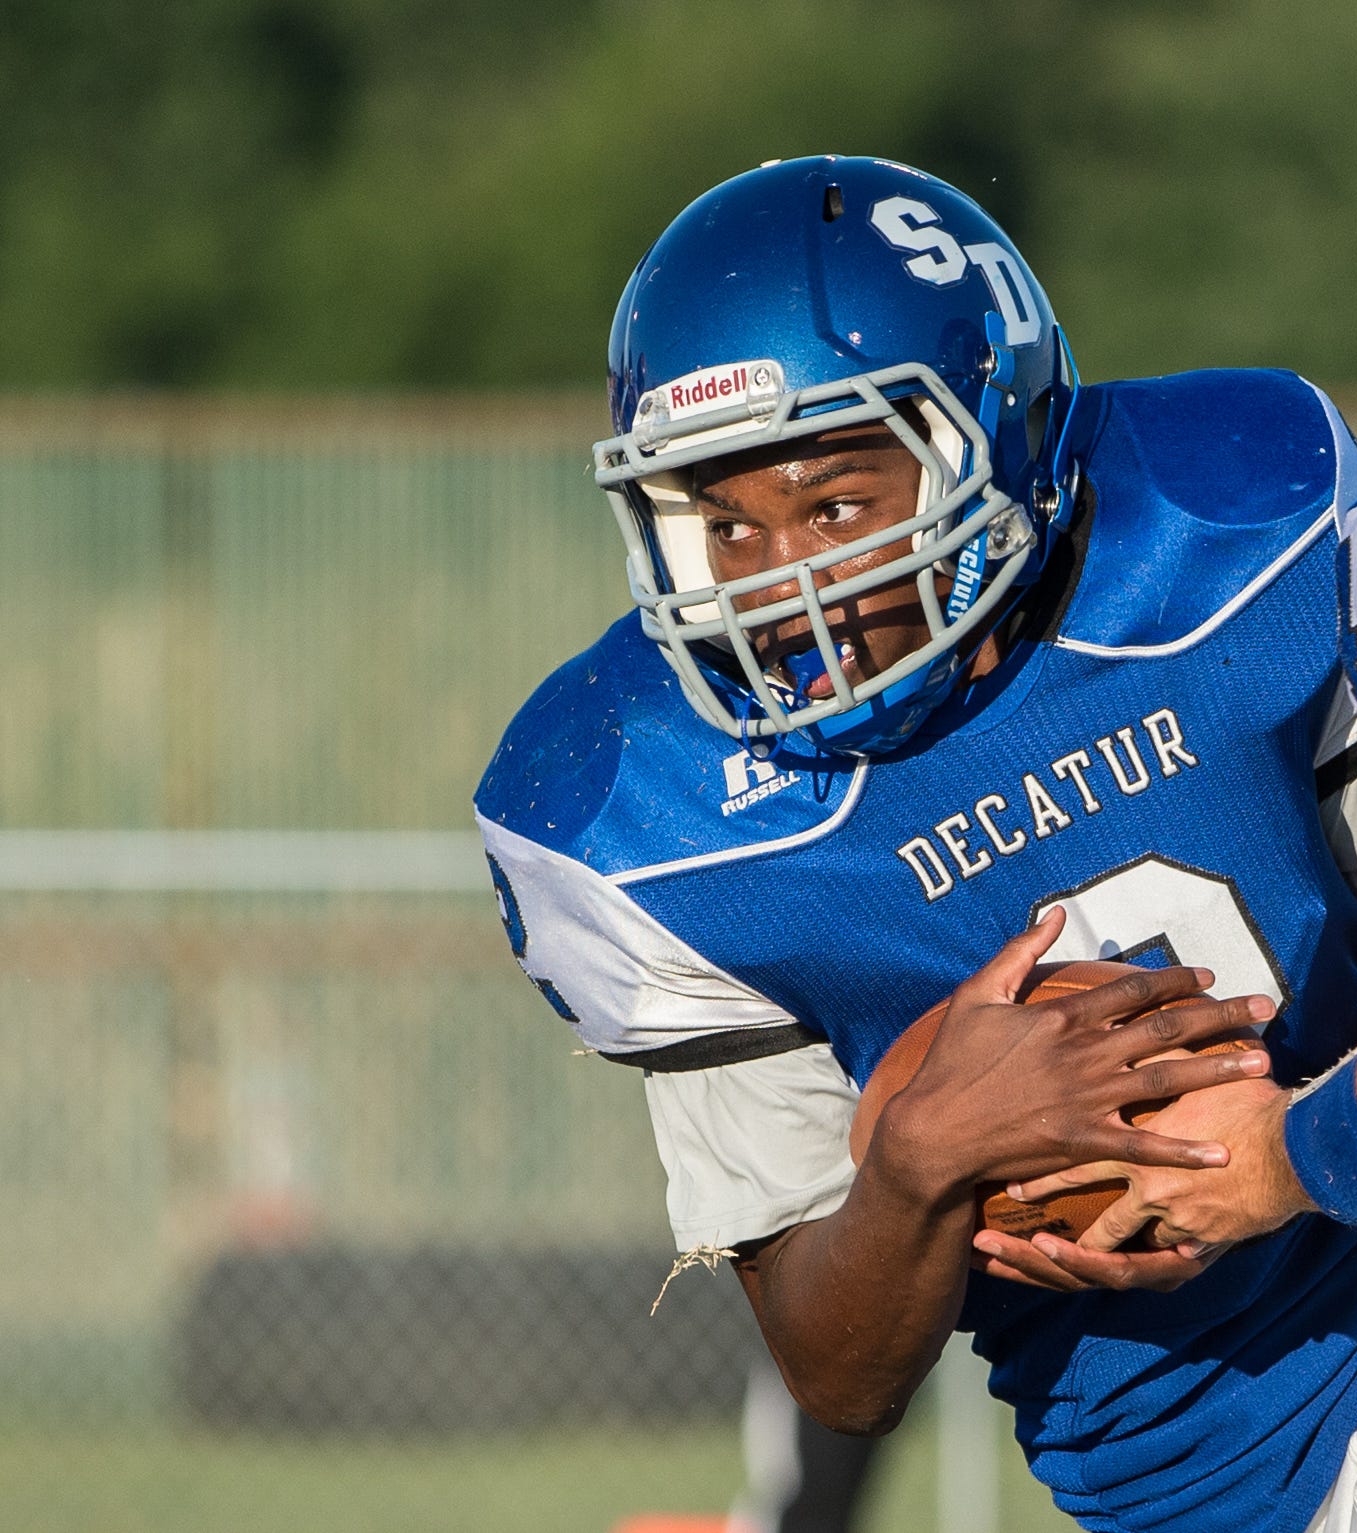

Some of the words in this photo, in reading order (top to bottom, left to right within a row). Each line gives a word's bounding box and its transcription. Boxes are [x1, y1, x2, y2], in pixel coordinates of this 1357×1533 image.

[670, 367, 748, 409] Riddell
[720, 770, 801, 817] RUSSELL
[895, 706, 1200, 904] DECATUR
